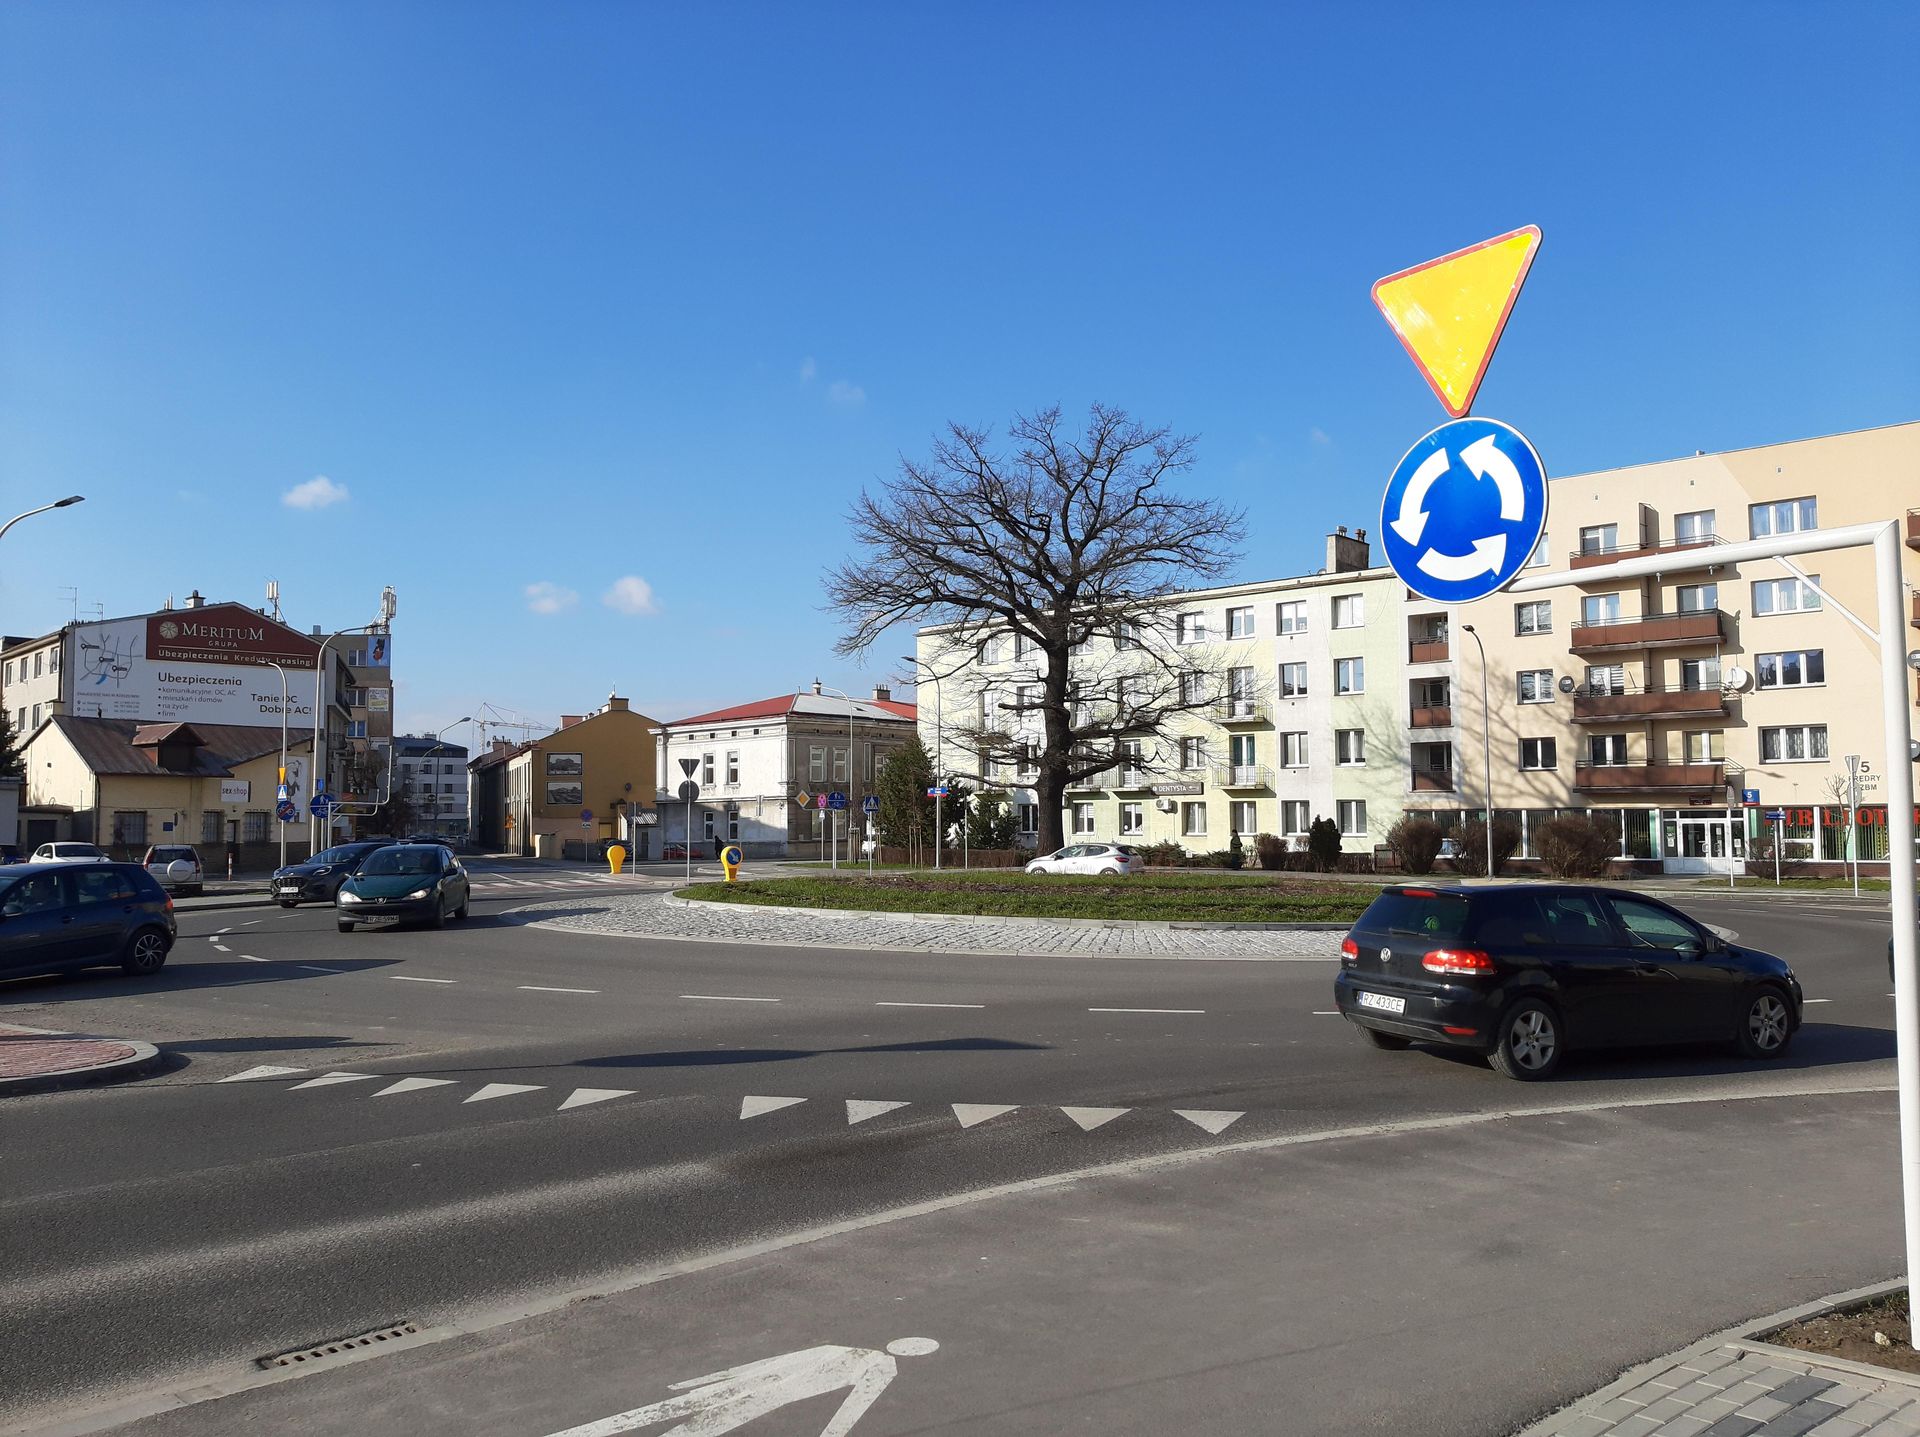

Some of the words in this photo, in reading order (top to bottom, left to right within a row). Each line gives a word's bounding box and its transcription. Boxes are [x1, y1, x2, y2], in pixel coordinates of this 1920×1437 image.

[182, 622, 264, 641] MERITUM
[208, 640, 238, 648] GRUPA
[158, 649, 229, 661] Ubezpieczenia
[276, 657, 314, 667] Leasingi
[158, 672, 242, 686] Ubezpieczenia
[251, 693, 280, 703] Tanie
[282, 695, 298, 703] OC
[1860, 761, 1870, 773] 5
[1747, 791, 1753, 799] 5
[1363, 993, 1374, 1005] RZ
[1376, 996, 1403, 1011] 433CE
